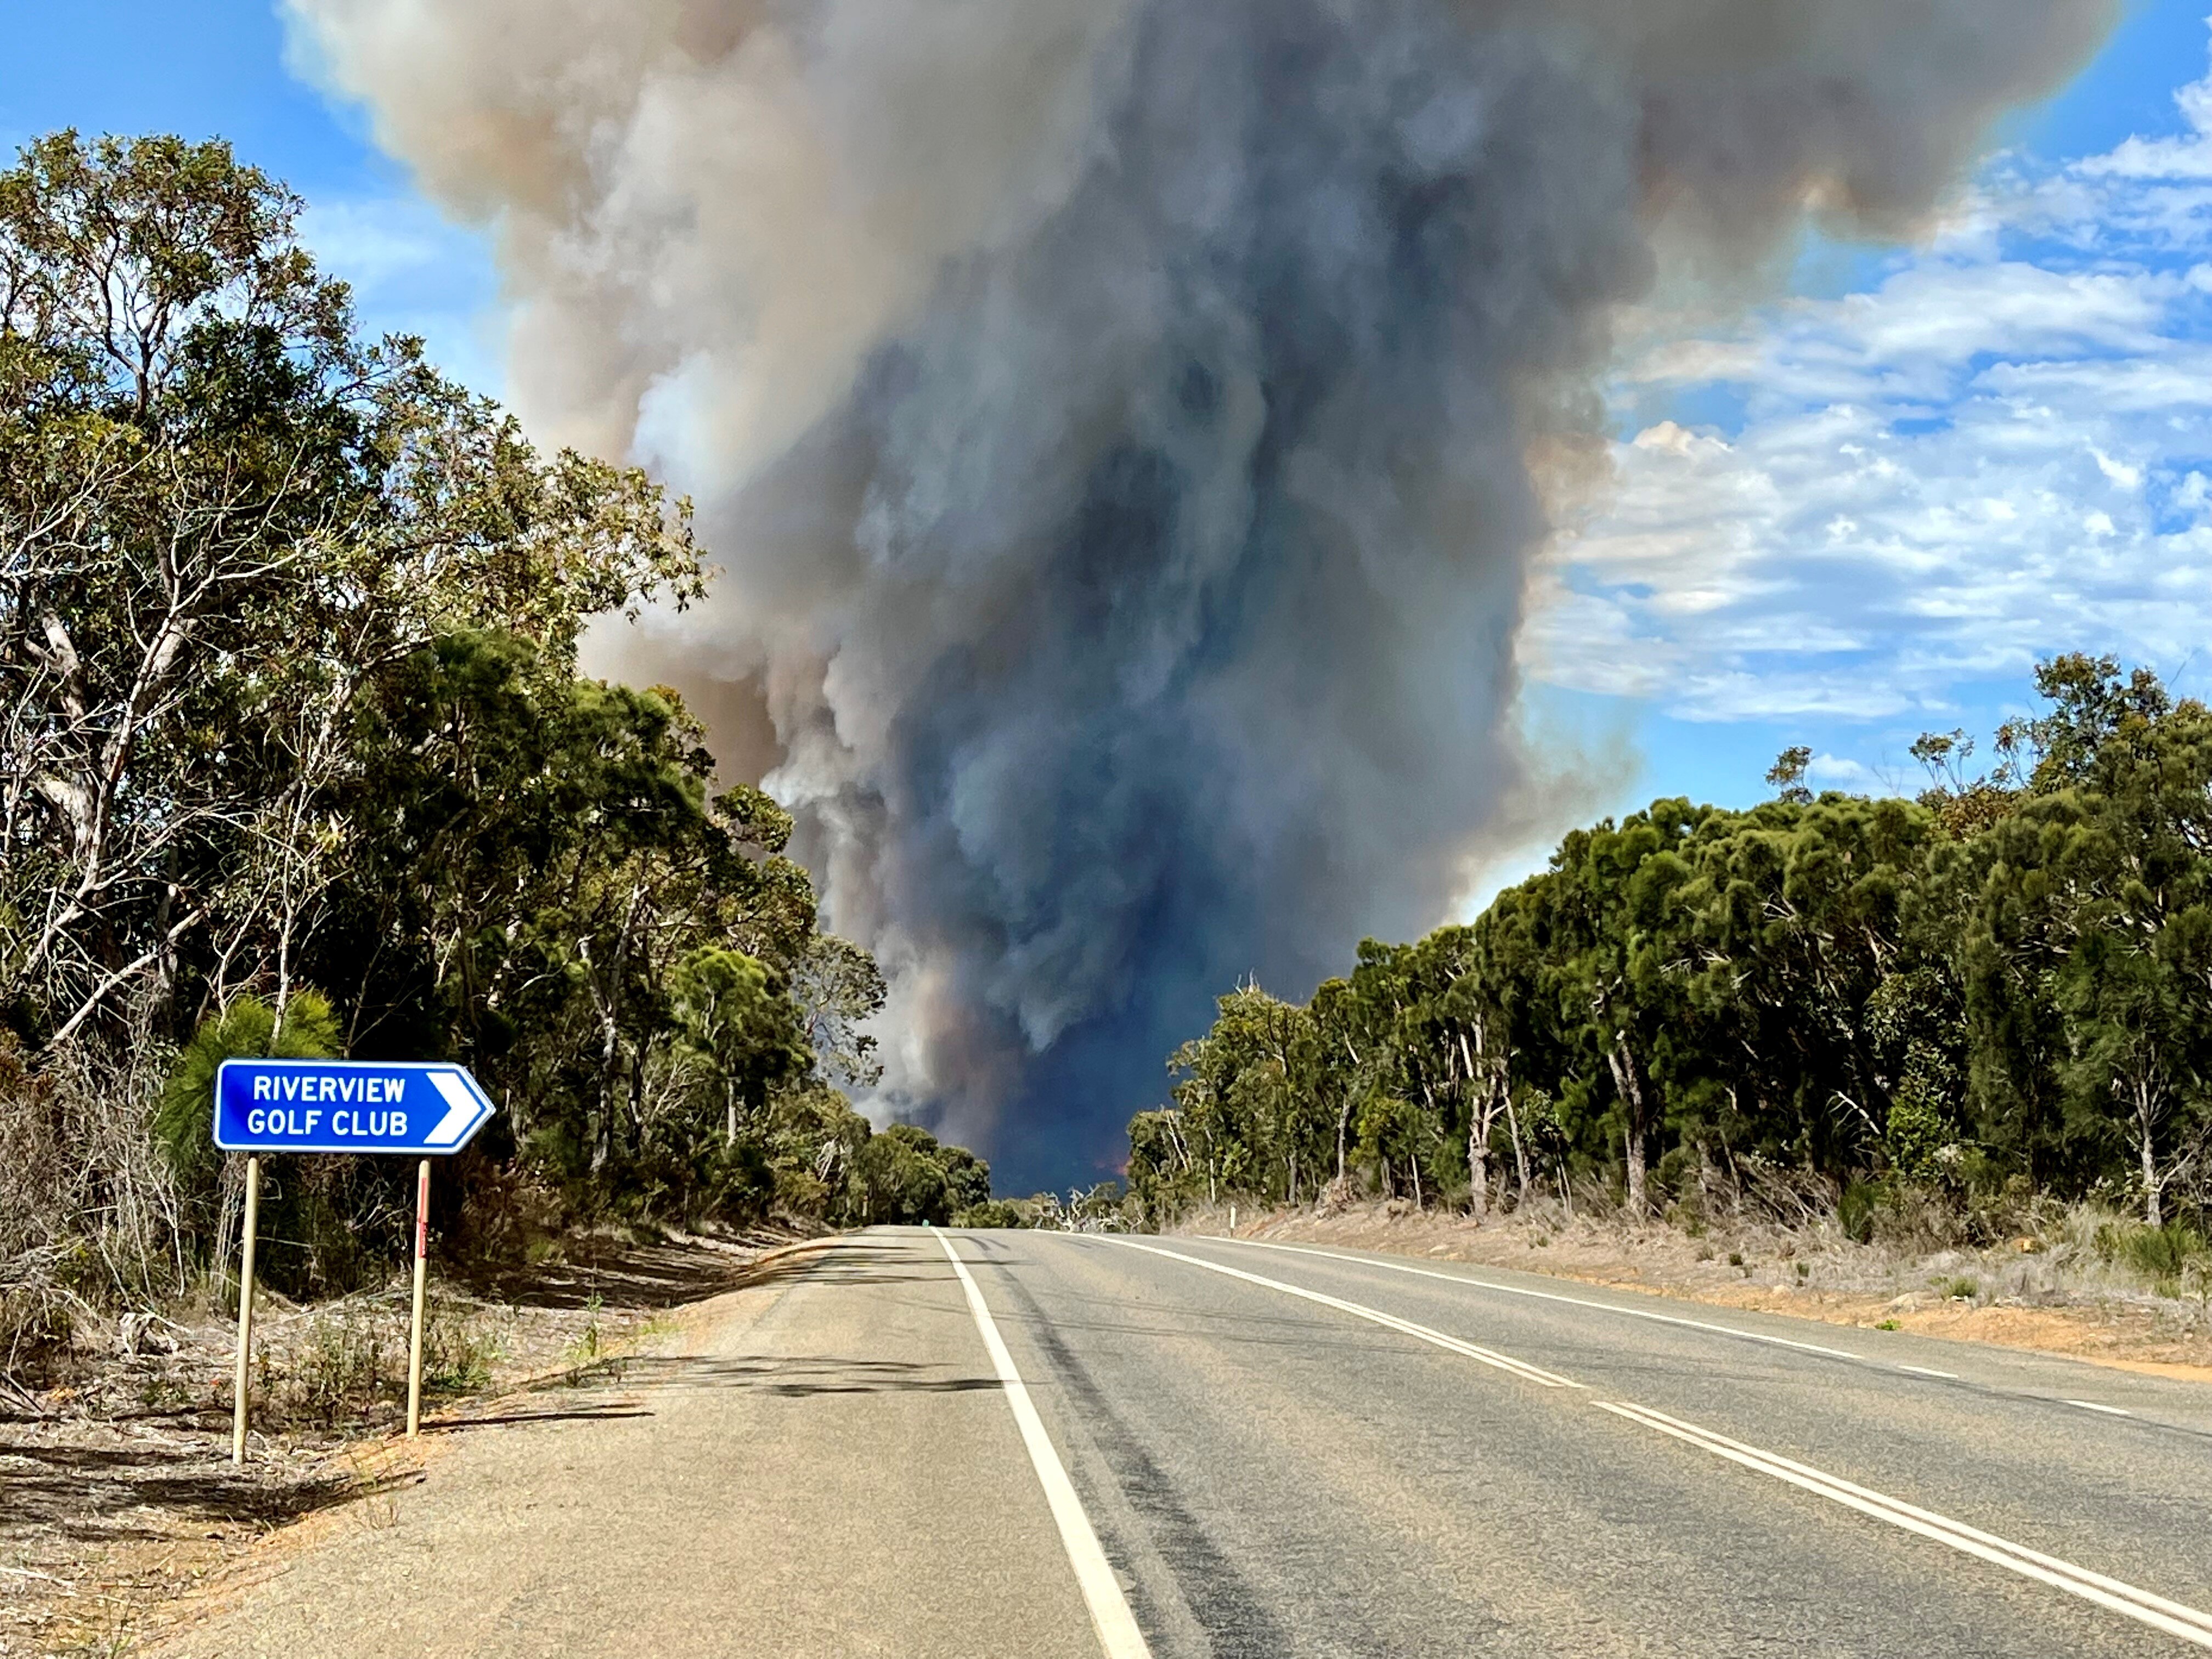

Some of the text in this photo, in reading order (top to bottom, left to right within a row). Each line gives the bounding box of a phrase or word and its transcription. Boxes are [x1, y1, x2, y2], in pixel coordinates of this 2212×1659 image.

[253, 1075, 405, 1102] RIVERVIEW
[247, 1109, 408, 1136] GOLF CLUB
